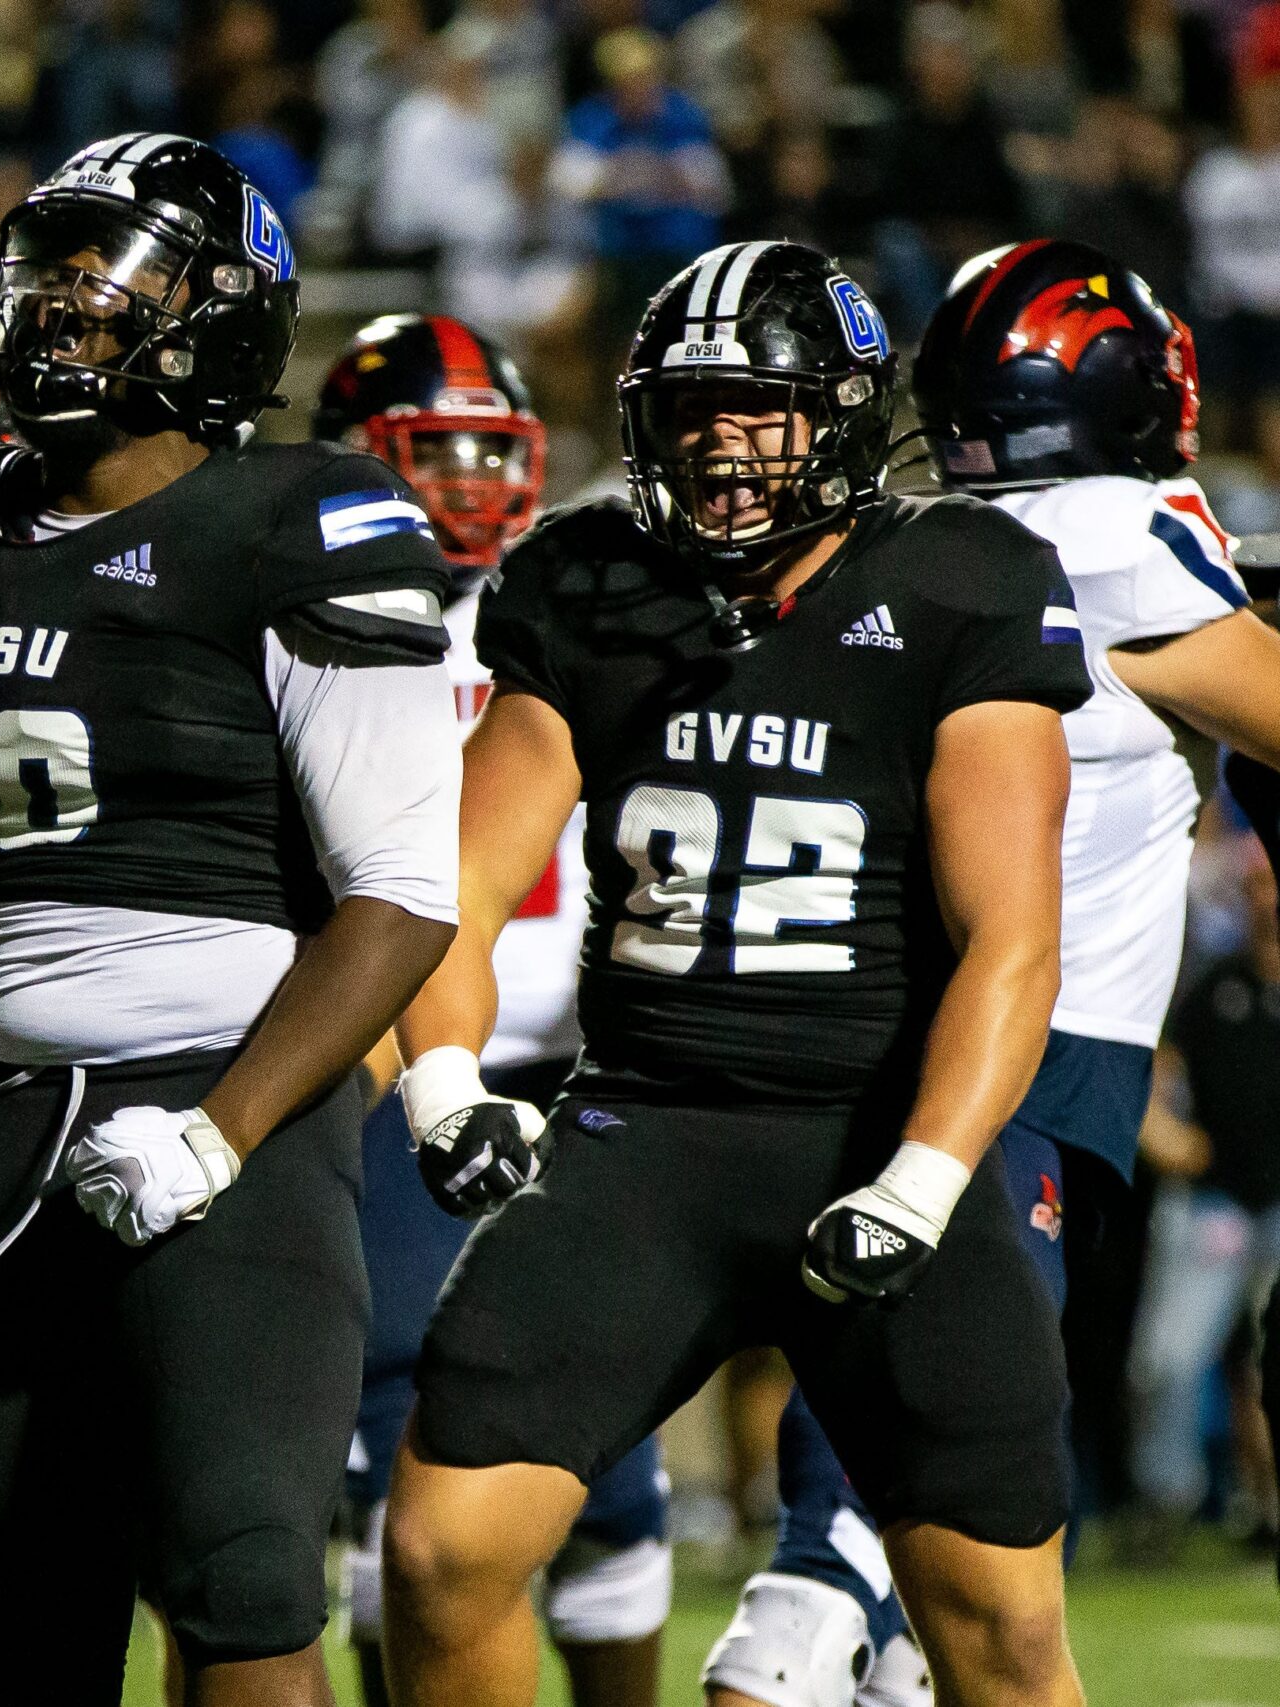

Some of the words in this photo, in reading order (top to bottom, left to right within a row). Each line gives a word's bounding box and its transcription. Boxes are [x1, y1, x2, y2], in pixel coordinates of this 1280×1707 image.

[685, 343, 723, 357] GVSU
[93, 562, 157, 587] adidas
[841, 629, 904, 650] adidas
[666, 711, 831, 775] GVSU
[425, 1108, 474, 1145] adidas
[851, 1214, 907, 1251] adidas
